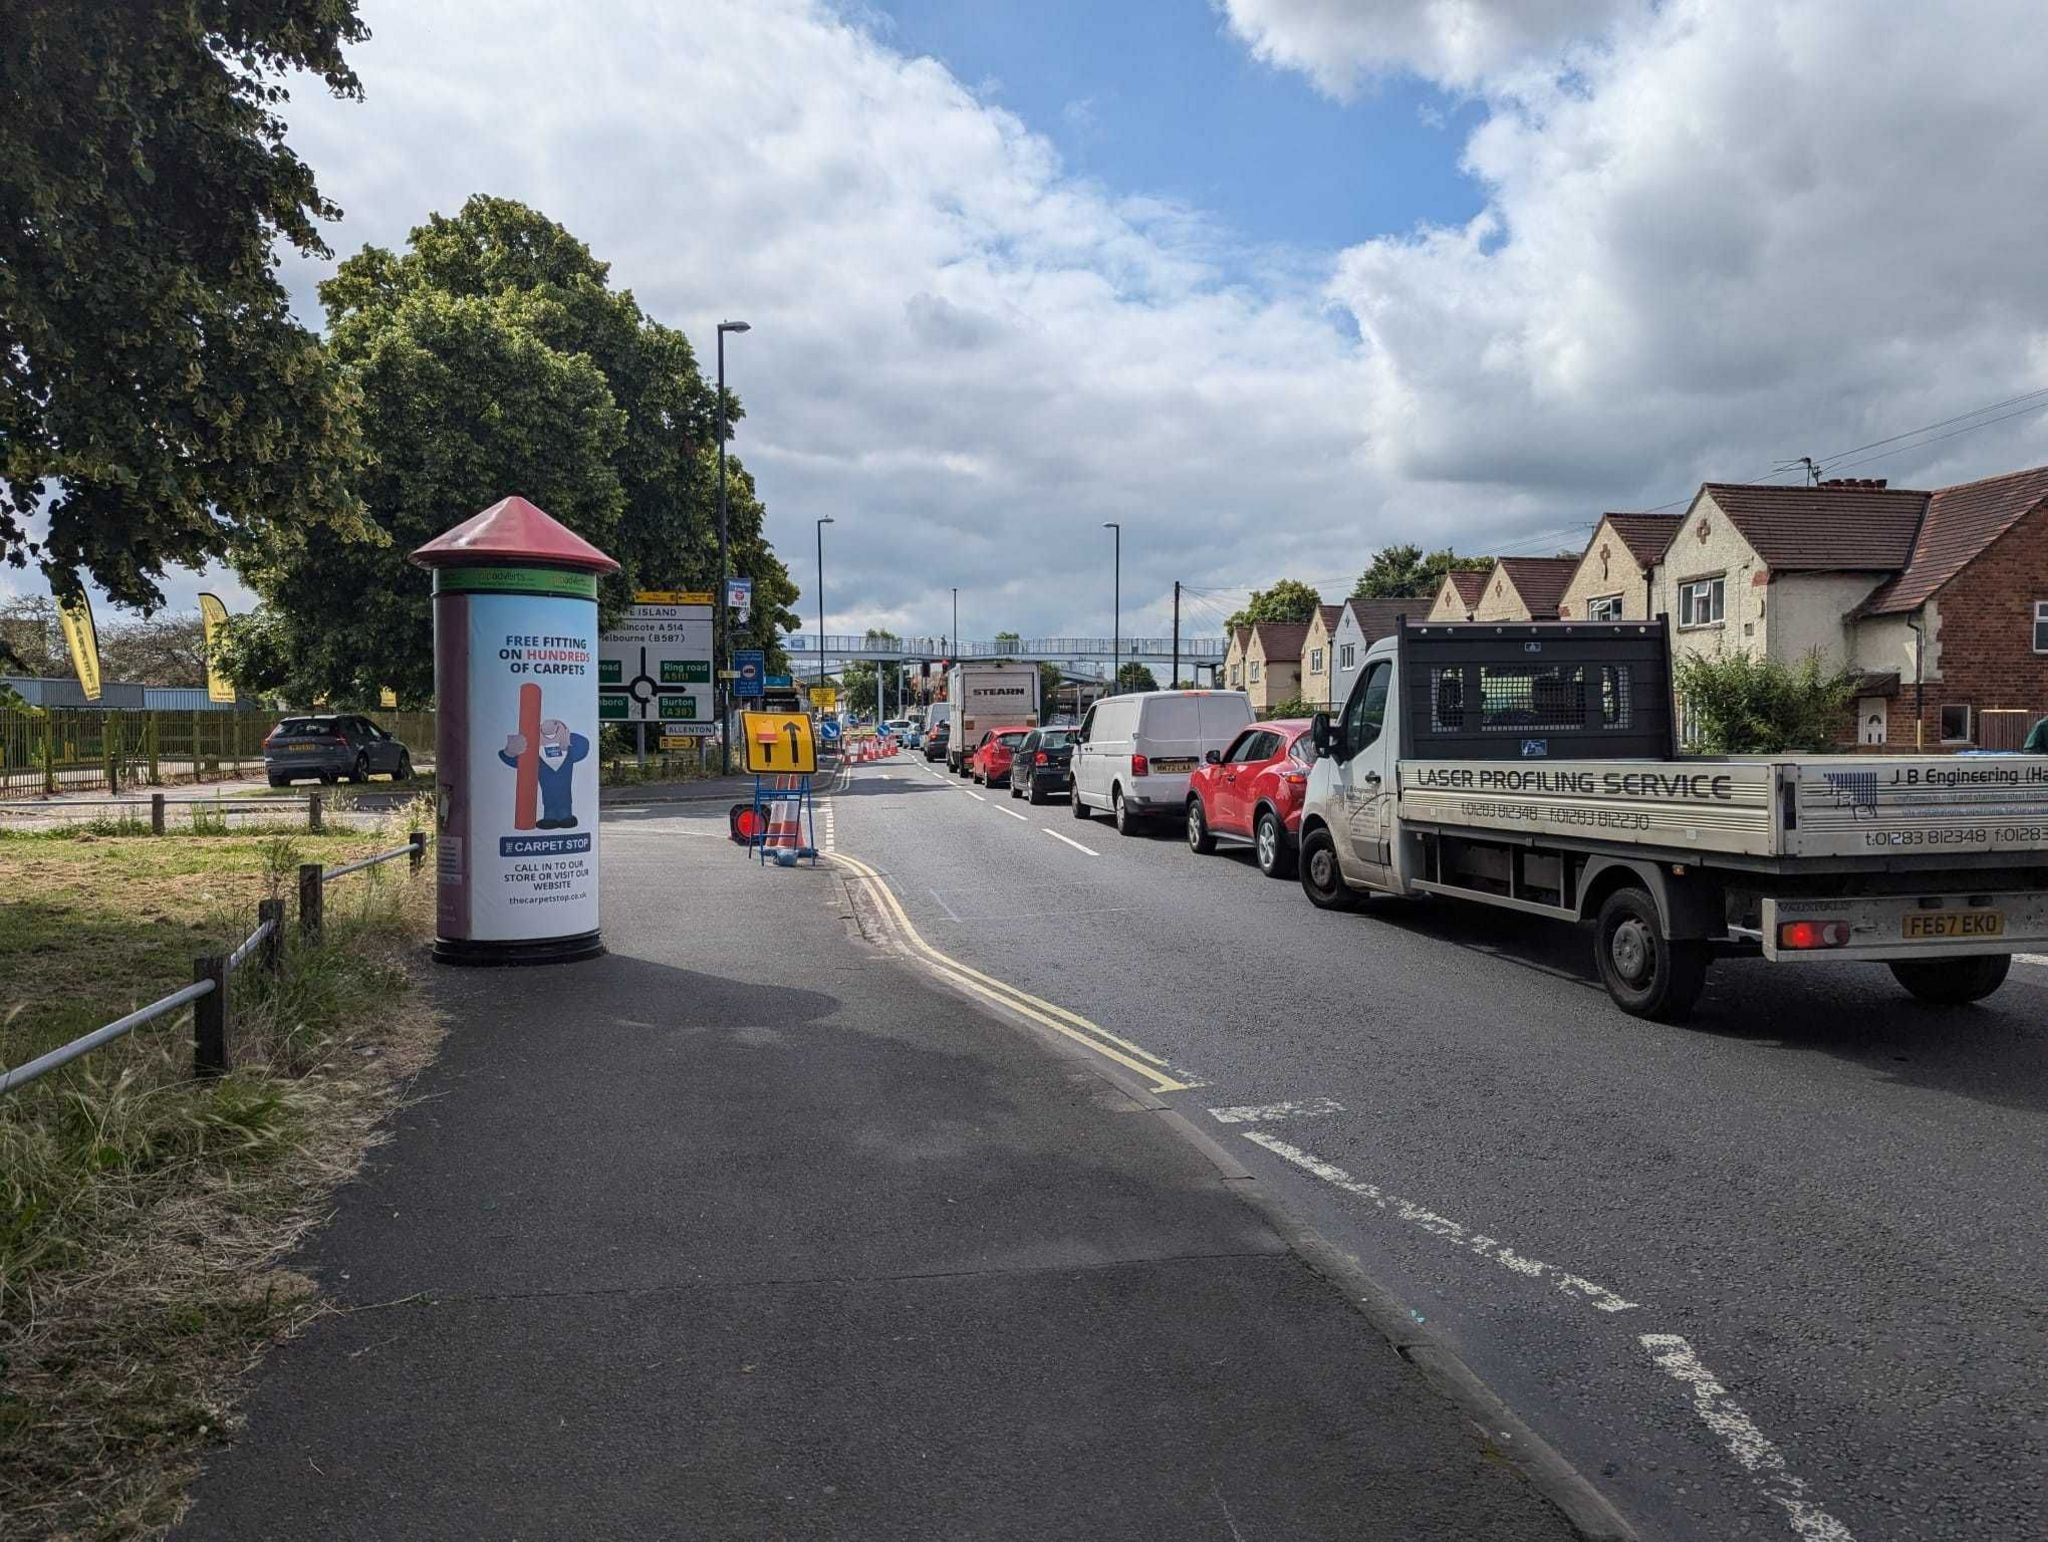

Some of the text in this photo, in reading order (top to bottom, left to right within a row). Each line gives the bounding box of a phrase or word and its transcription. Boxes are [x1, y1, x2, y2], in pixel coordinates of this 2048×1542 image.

[639, 608, 677, 617] ISLAND
[505, 635, 587, 650] FREE FITTING
[498, 648, 590, 663] ON HUNDREDS
[510, 662, 585, 676] OF CARPETS
[663, 662, 708, 673] Ring road
[973, 687, 1025, 696] STEARN
[661, 697, 694, 707] Burton
[669, 726, 712, 734] ALLENTON
[1890, 768, 1900, 785] J
[1907, 768, 1919, 784] B
[1926, 766, 2019, 787] Engineering
[1417, 768, 1733, 801] LASER PROFILING SERVICE
[1865, 830, 1923, 846] t:01283
[1928, 828, 1987, 845] 812348
[514, 840, 563, 852] CARPET
[566, 838, 589, 850] STOP
[514, 859, 584, 873] CALL IN TO OUR
[504, 868, 589, 883] STORE OR VISIT OUR
[533, 880, 571, 891] WEBSITE
[1910, 917, 1955, 936] FE67
